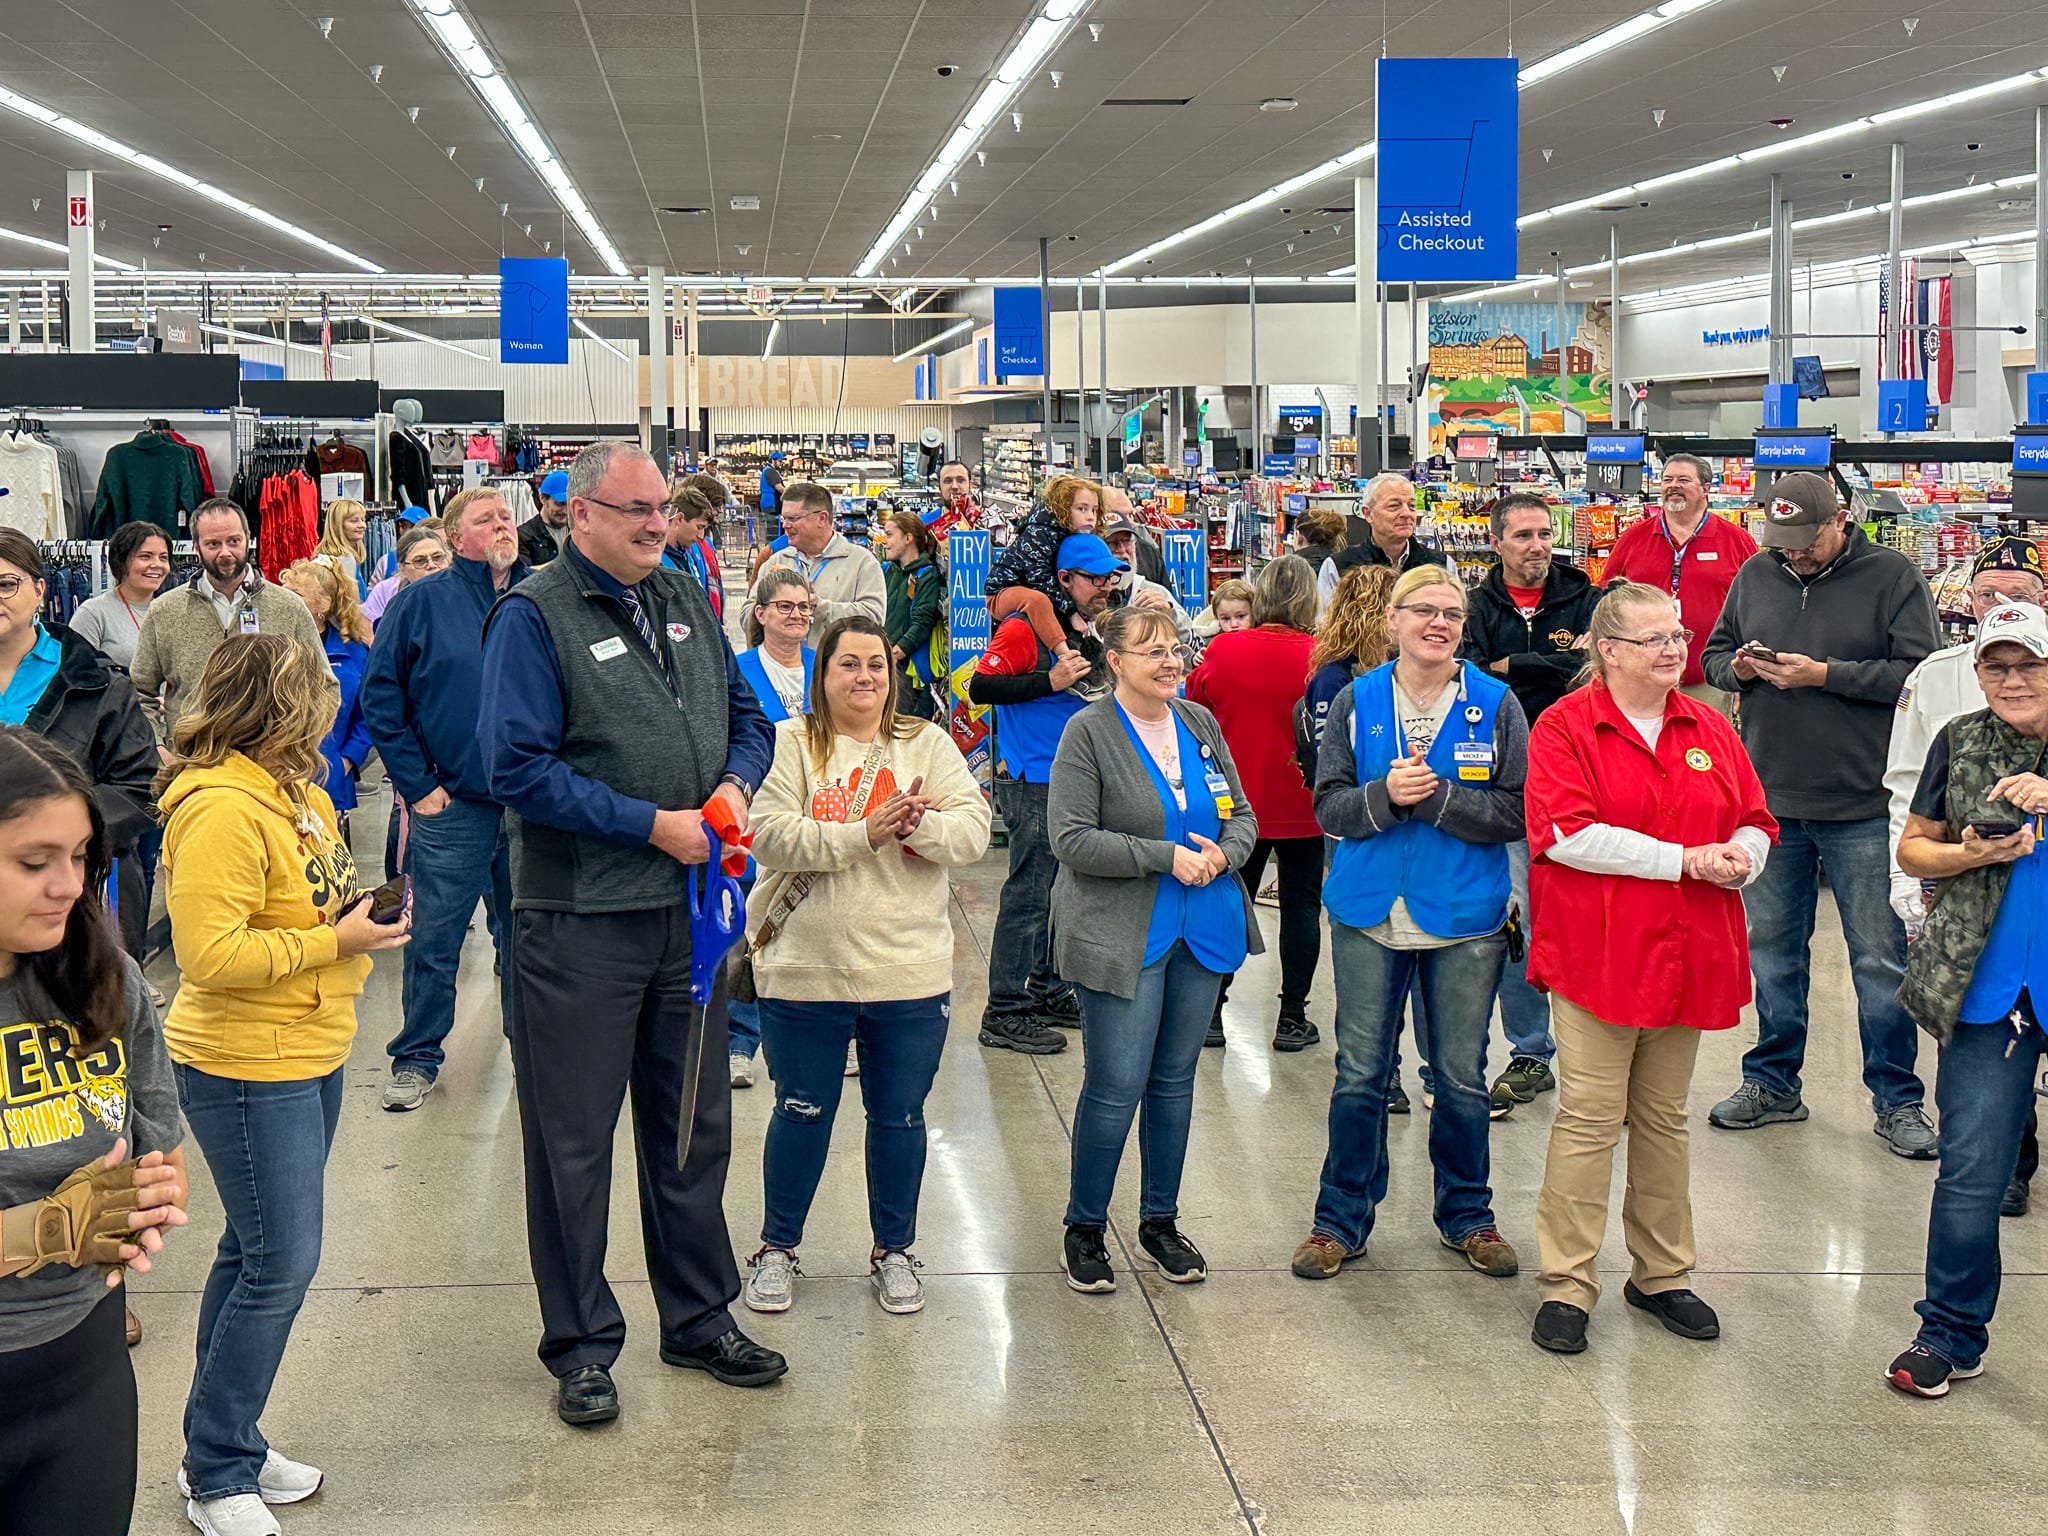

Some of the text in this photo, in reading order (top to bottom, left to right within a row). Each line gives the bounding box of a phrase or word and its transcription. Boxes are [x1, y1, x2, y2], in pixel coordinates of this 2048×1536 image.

[1398, 210, 1471, 227] Assisted
[1398, 234, 1485, 250] Checkout
[751, 288, 769, 299] EXIT
[1429, 310, 1477, 326] celsior
[509, 340, 544, 350] Women
[1429, 325, 1489, 348] Springs
[1001, 346, 1017, 355] Self
[1001, 356, 1037, 364] Checkout
[709, 358, 848, 408] BREAD
[1772, 404, 1778, 425] 1
[1894, 403, 1902, 425] 2
[1128, 440, 1139, 448] 43
[2019, 446, 2048, 463] Everyda
[951, 536, 987, 564] TRY
[952, 569, 987, 599] ALL
[953, 607, 988, 628] YOUR
[952, 637, 988, 650] FAVES!
[852, 744, 884, 816] MICHAEL KORS
[0, 1019, 127, 1104] ERS
[3, 1094, 84, 1149] SPRINGS
